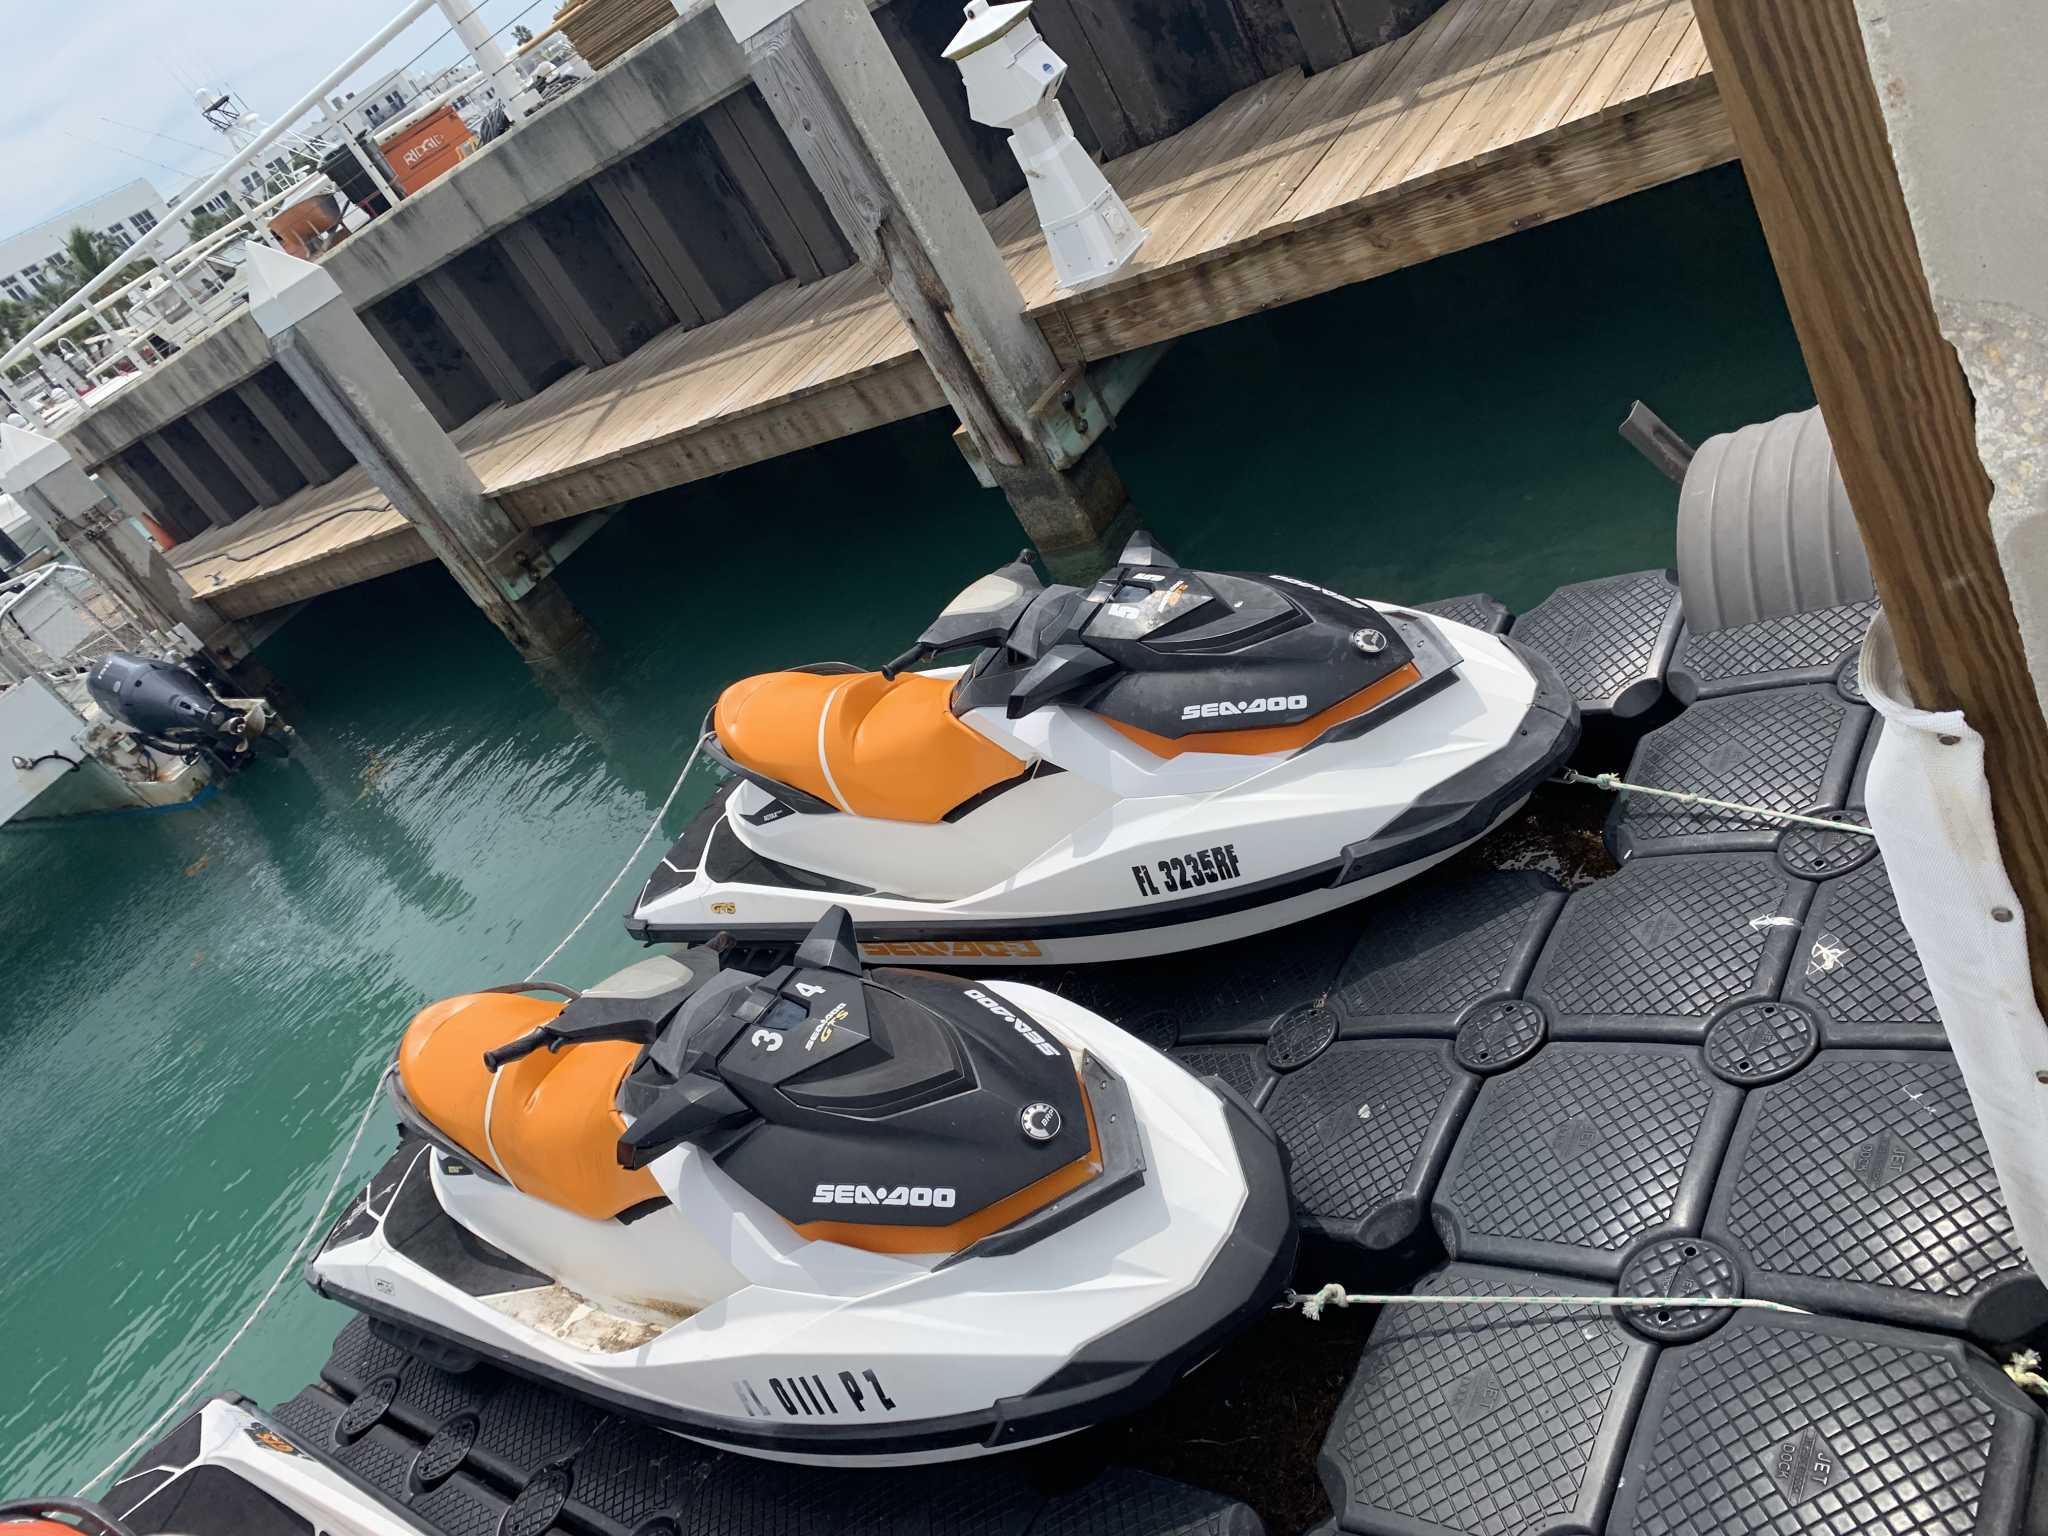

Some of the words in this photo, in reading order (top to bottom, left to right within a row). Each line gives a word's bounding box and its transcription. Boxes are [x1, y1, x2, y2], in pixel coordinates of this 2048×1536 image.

[402, 134, 444, 167] RIDGID
[1131, 865, 1160, 897] FL
[1158, 844, 1241, 892] 3235RF
[751, 1029, 784, 1052] 3
[795, 982, 827, 998] 4
[820, 1009, 849, 1043] GTS
[1041, 1109, 1054, 1127] BRP
[1774, 1443, 1797, 1479] DOCK
[1811, 1452, 1832, 1486] JET
